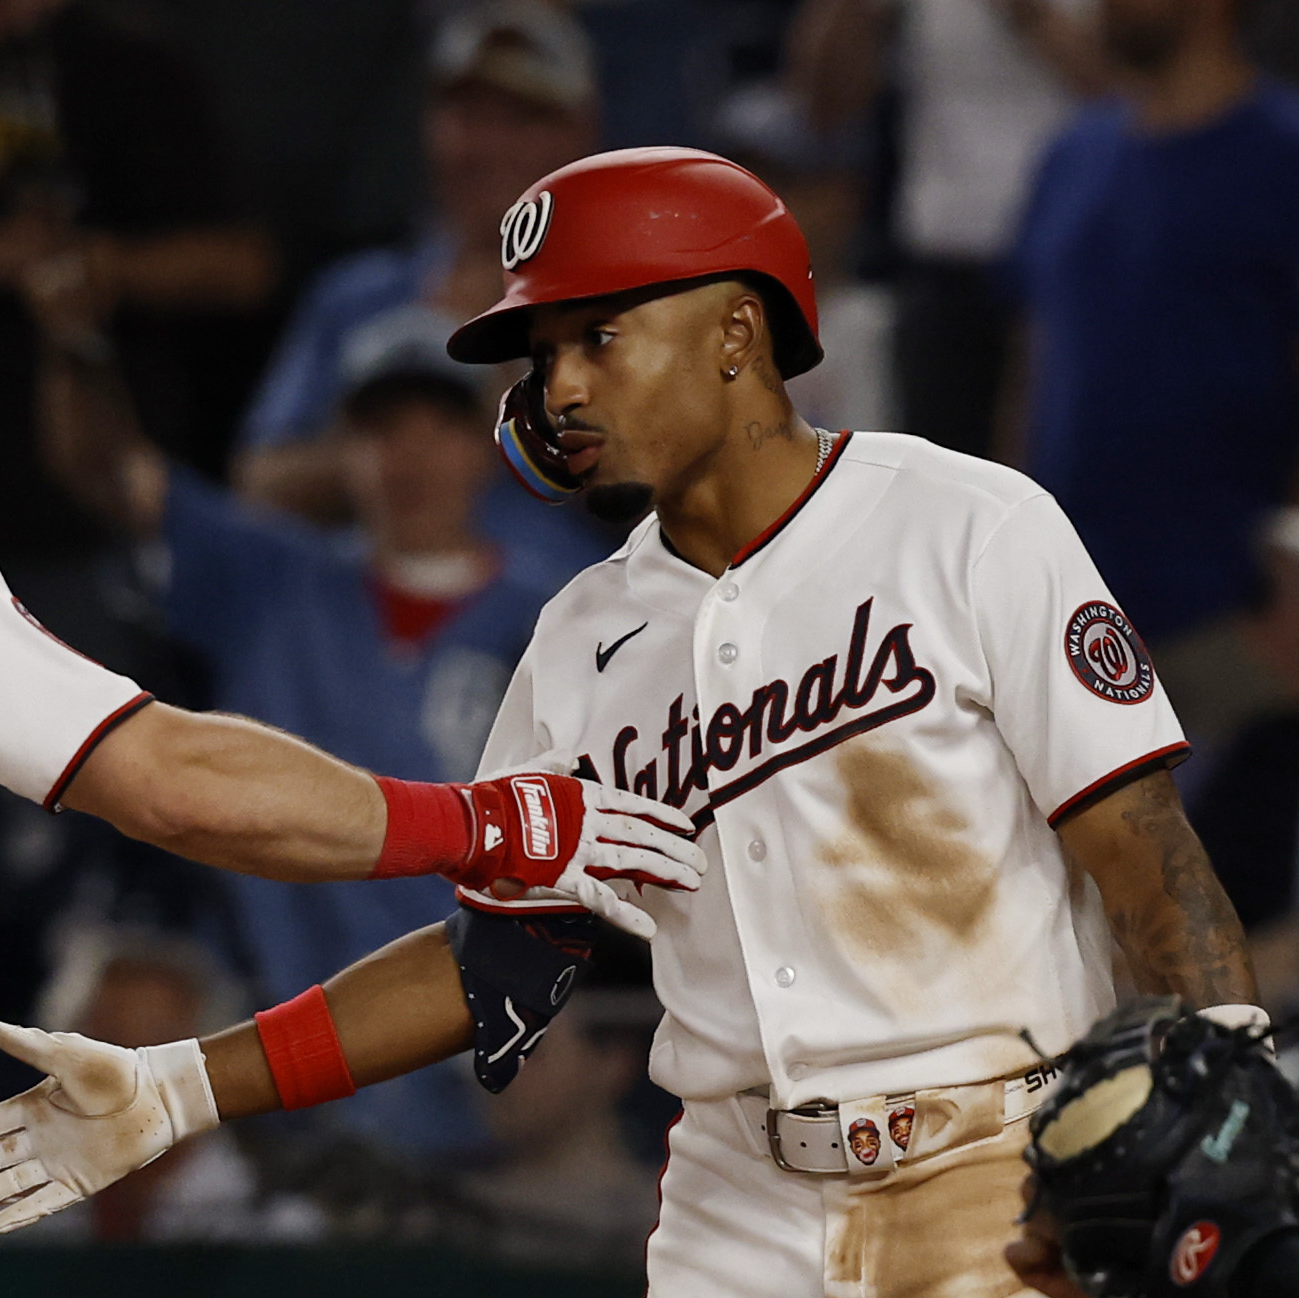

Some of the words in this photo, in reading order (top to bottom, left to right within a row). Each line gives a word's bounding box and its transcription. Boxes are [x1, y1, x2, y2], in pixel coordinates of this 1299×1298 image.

[1069, 605, 1133, 657] WASHINGTON
[1093, 662, 1150, 700] NATIONALS
[514, 780, 552, 856] Franklin
